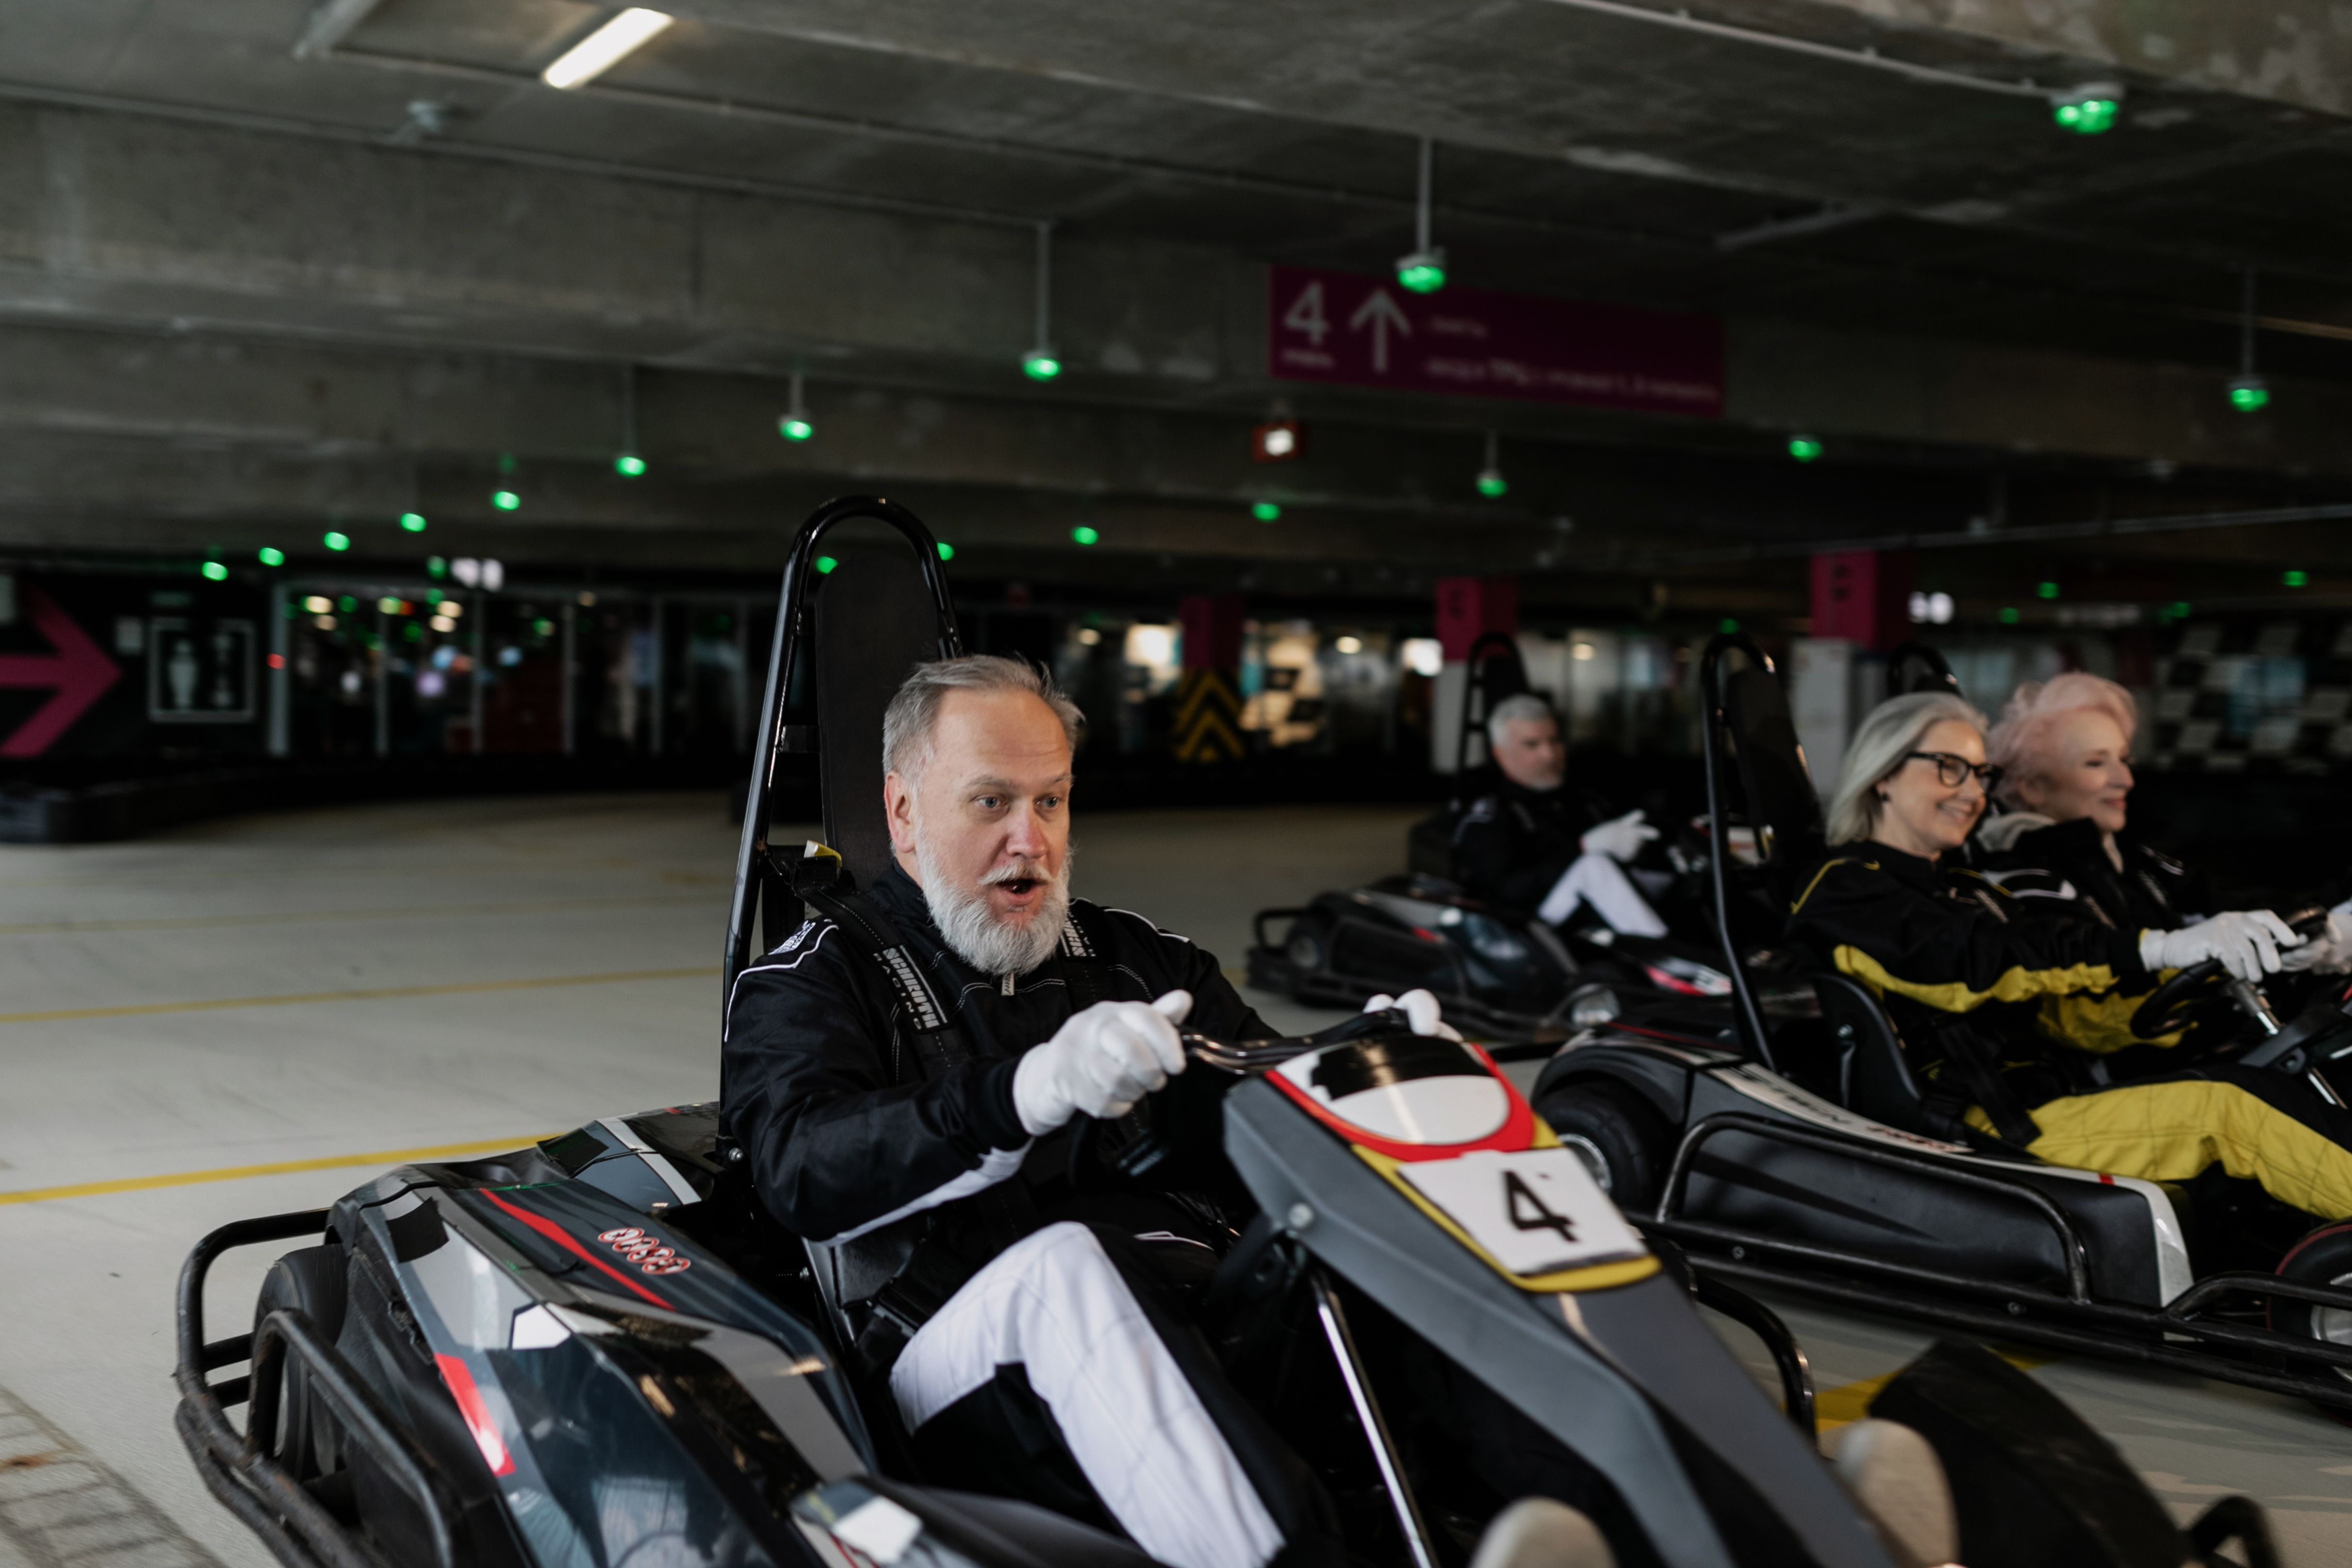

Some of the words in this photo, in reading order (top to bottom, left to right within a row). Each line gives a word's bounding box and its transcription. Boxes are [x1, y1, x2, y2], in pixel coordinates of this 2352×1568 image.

[1283, 279, 1332, 345] 4
[873, 952, 922, 1029] RACING
[882, 947, 940, 1028] SCHROTH
[1502, 1170, 1579, 1242] 4
